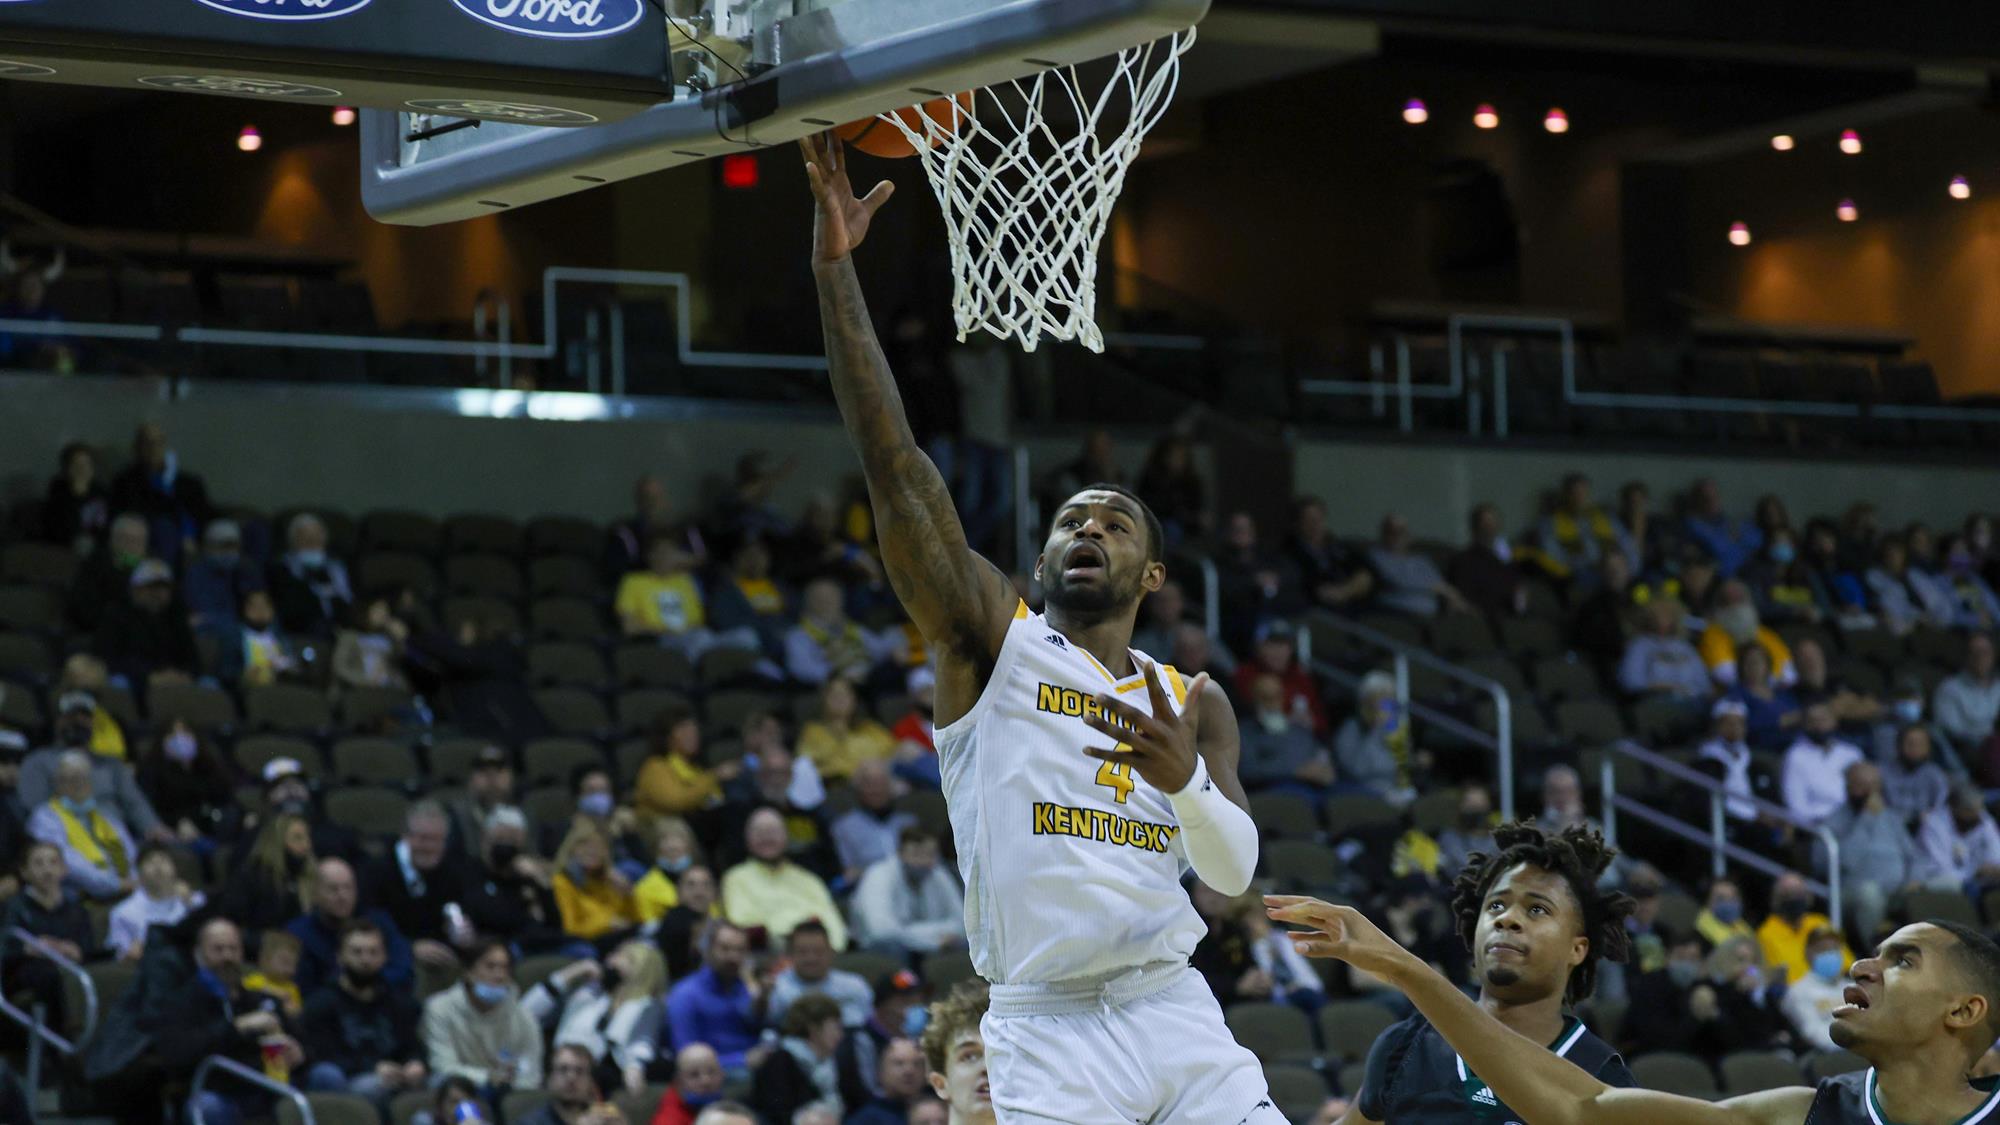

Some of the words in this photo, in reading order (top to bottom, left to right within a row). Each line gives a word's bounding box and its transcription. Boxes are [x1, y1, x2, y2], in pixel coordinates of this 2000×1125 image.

[1095, 741, 1135, 804] 4
[1033, 802, 1181, 853] KENTUCKY
[1471, 1094, 1497, 1106] adidas
